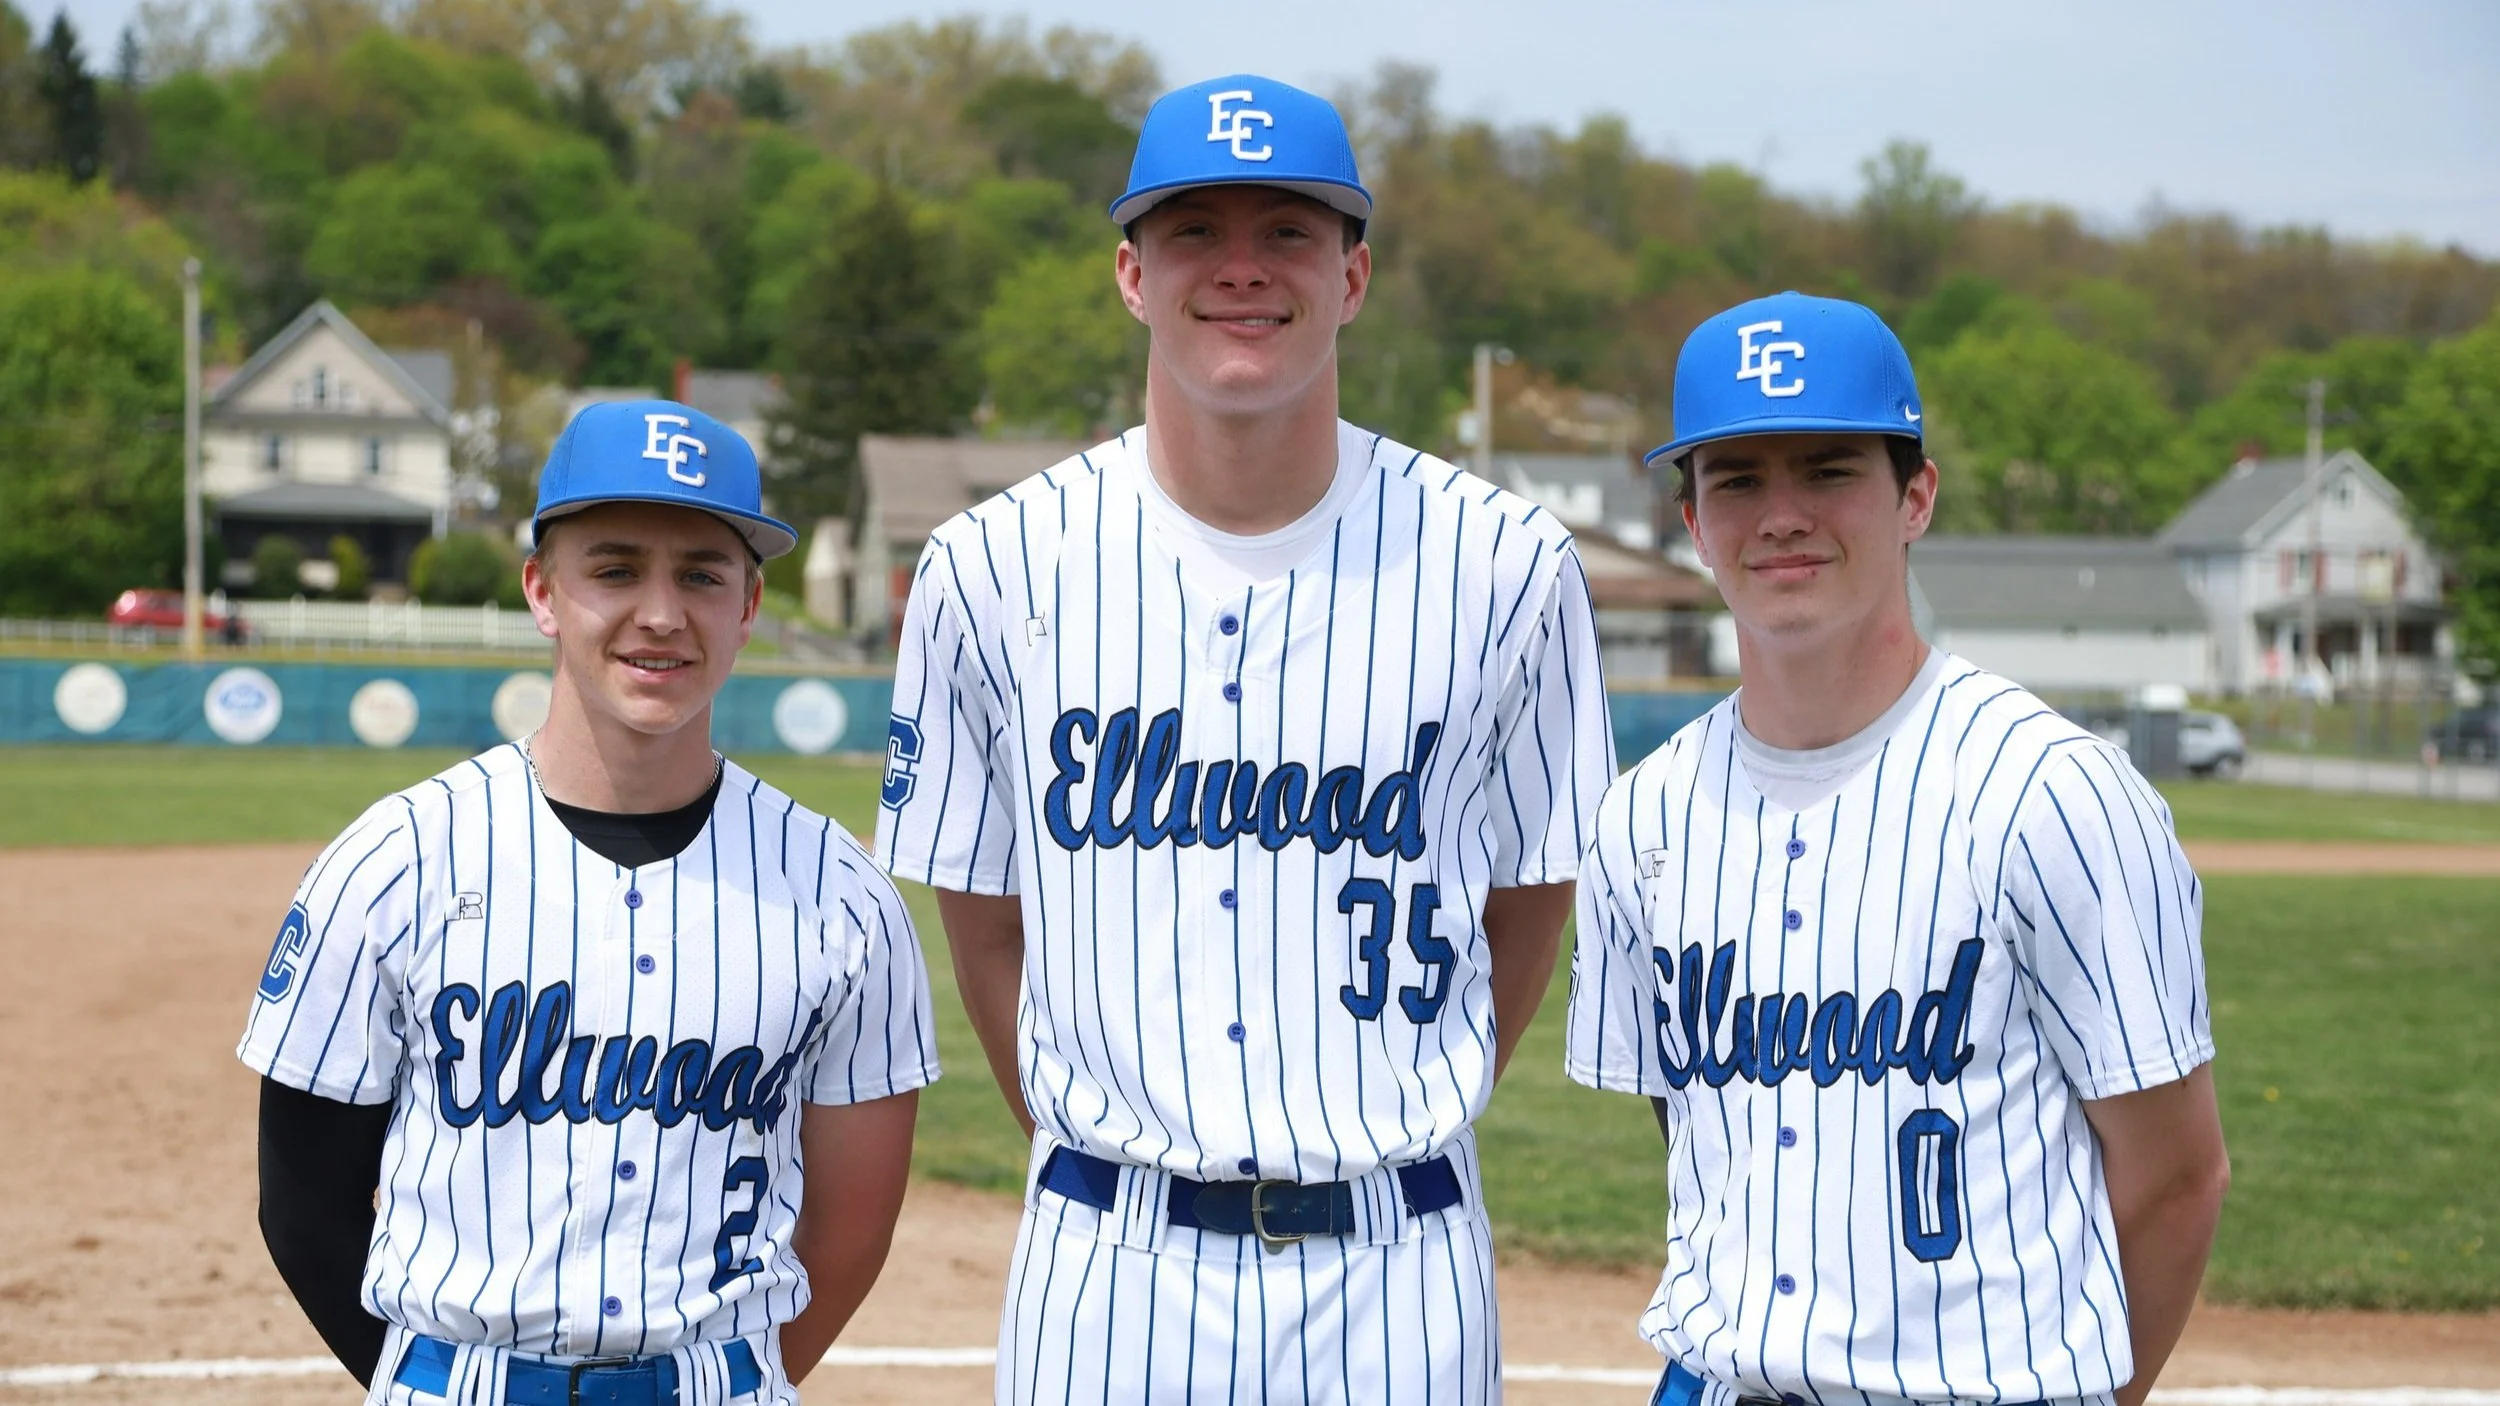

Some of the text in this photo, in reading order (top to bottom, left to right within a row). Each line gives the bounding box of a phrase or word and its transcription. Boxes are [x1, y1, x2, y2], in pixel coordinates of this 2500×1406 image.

[1206, 90, 1274, 163] EC
[1735, 320, 1806, 398] EC
[641, 414, 709, 489] EC
[1044, 706, 1441, 862] Ellwood
[1337, 877, 1455, 1025] 35
[1653, 937, 1985, 1089] Ellwood
[430, 980, 824, 1136] Ellwood
[708, 1155, 769, 1293] 2
[1897, 1108, 1963, 1263] 0
